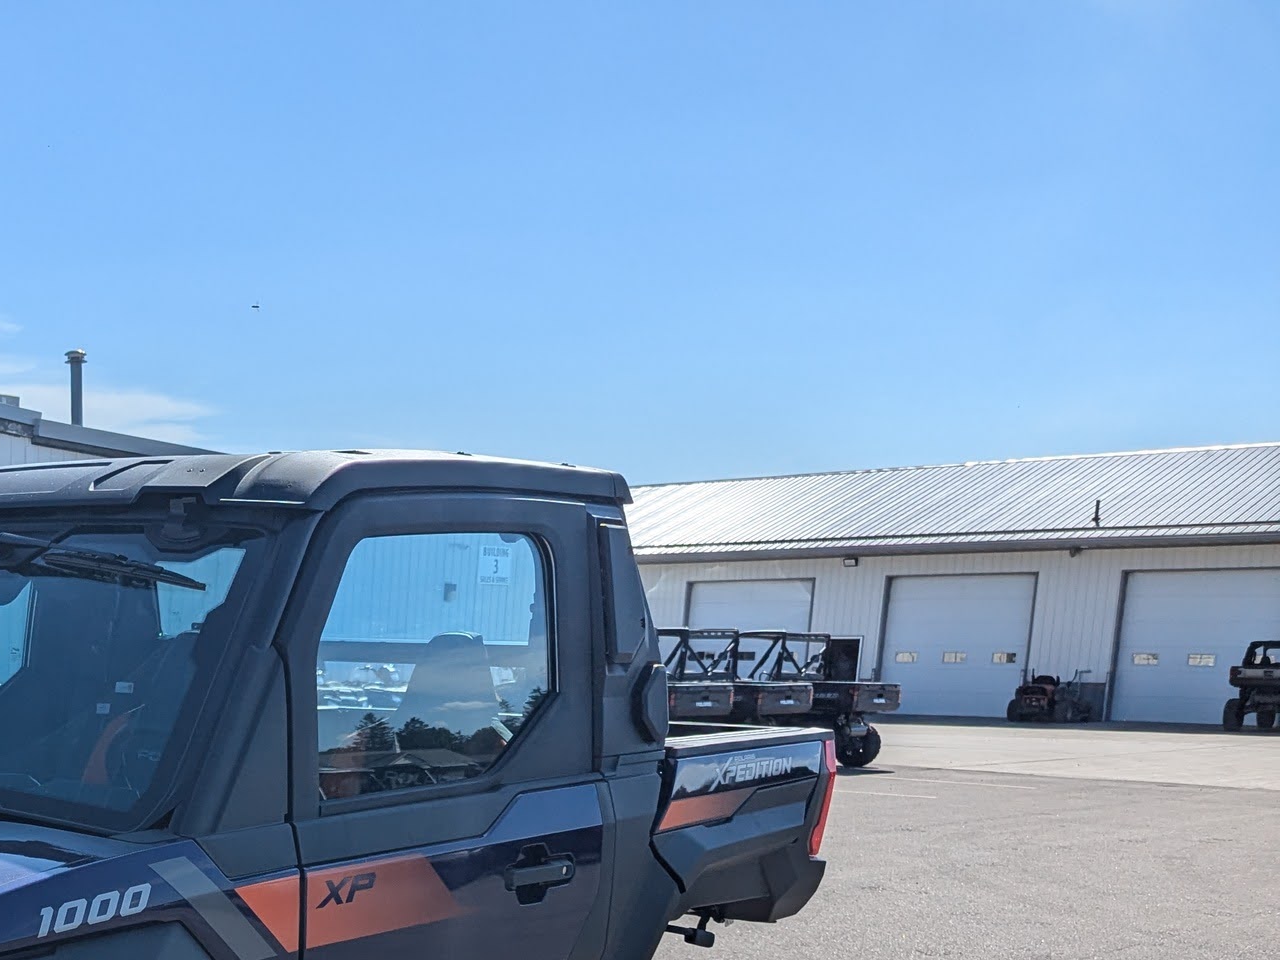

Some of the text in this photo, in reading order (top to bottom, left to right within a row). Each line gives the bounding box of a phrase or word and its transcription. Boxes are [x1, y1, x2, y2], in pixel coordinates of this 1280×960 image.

[492, 559, 499, 575] 3
[707, 756, 792, 792] XPEDITION
[316, 872, 376, 910] XP
[37, 883, 152, 938] 1000
